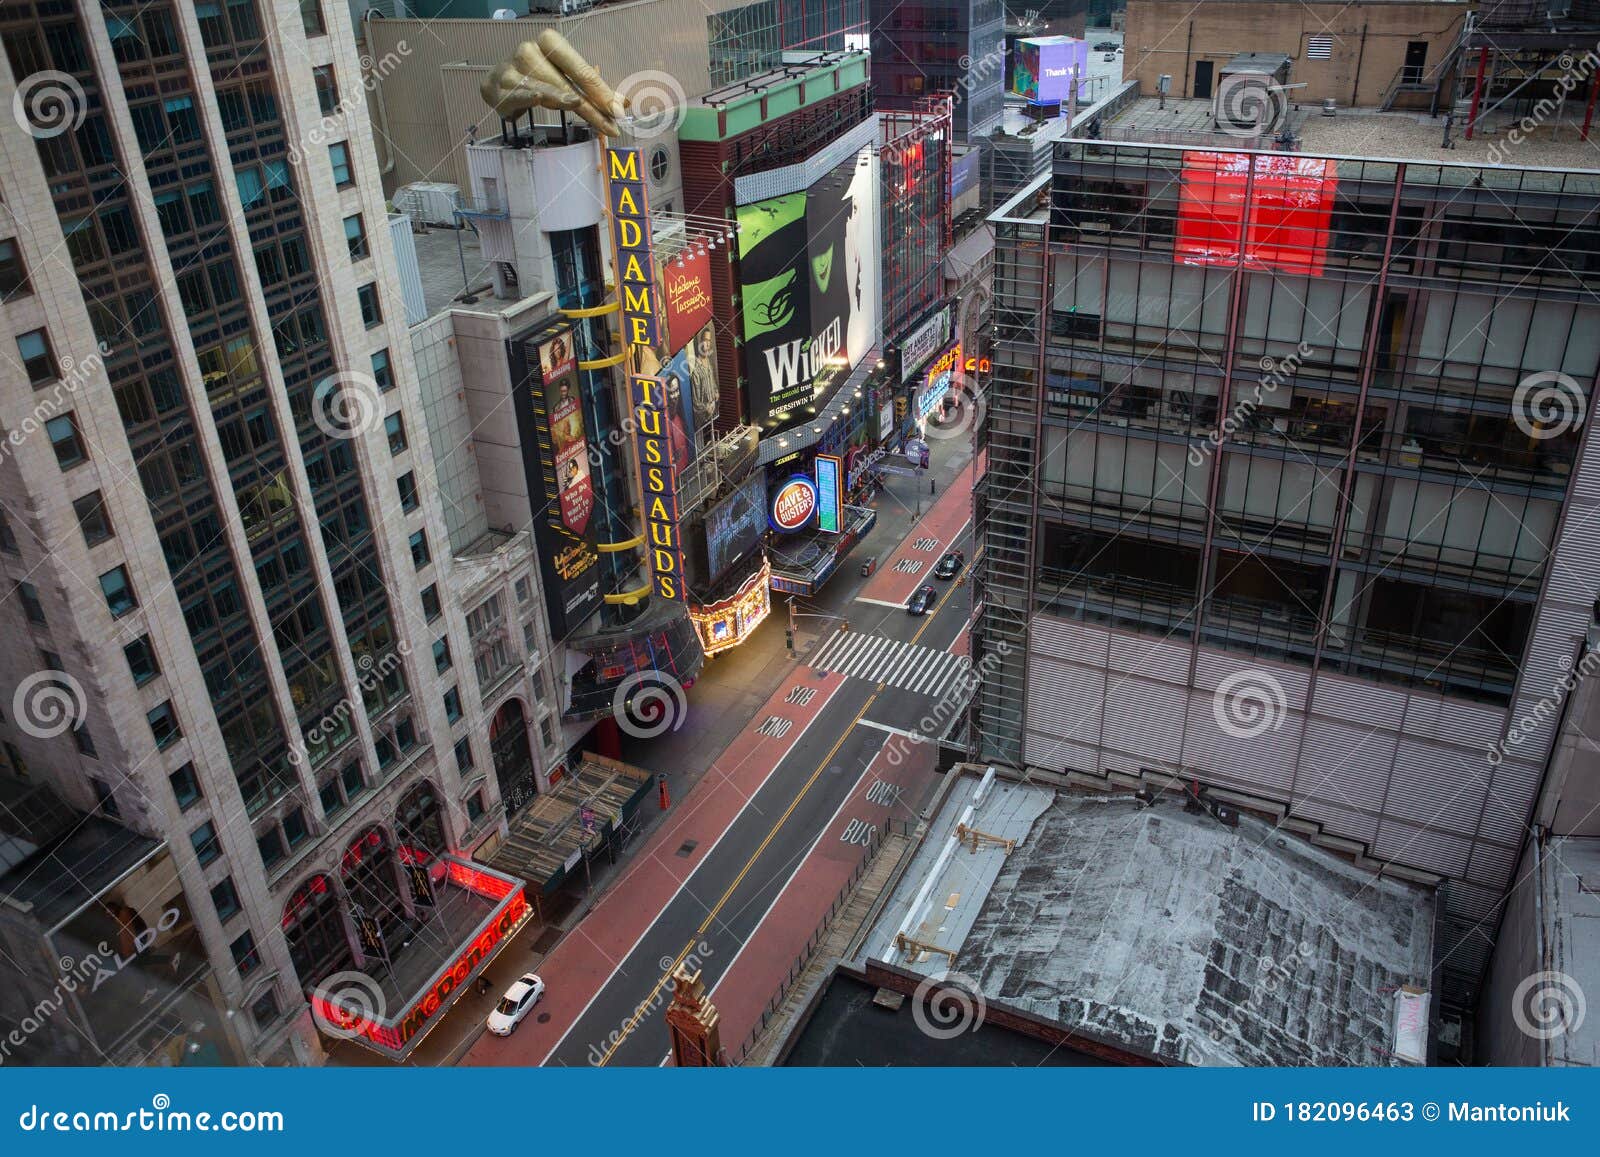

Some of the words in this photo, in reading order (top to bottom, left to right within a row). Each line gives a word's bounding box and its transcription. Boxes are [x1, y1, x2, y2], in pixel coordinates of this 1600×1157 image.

[1045, 67, 1067, 77] Thank
[610, 150, 652, 346] MADAME
[669, 274, 701, 299] Madame
[671, 285, 707, 315] Tussauds
[769, 394, 781, 403] The
[800, 383, 812, 392] true
[775, 396, 808, 415] GERSHWIN
[564, 490, 578, 502] Who
[579, 483, 588, 492] Do
[572, 495, 583, 506] You
[636, 379, 676, 600] TUSSAUD'S
[779, 491, 803, 515] DAVE
[802, 487, 811, 498] &
[780, 498, 813, 523] BUSTER'S
[554, 542, 588, 570] Madame
[912, 538, 938, 552] BUS
[892, 559, 923, 574] ONLY
[784, 685, 818, 707] BUS
[754, 715, 793, 738] ONLY
[865, 780, 906, 807] ONLY
[840, 818, 877, 846] BUS
[91, 908, 180, 992] ALDO
